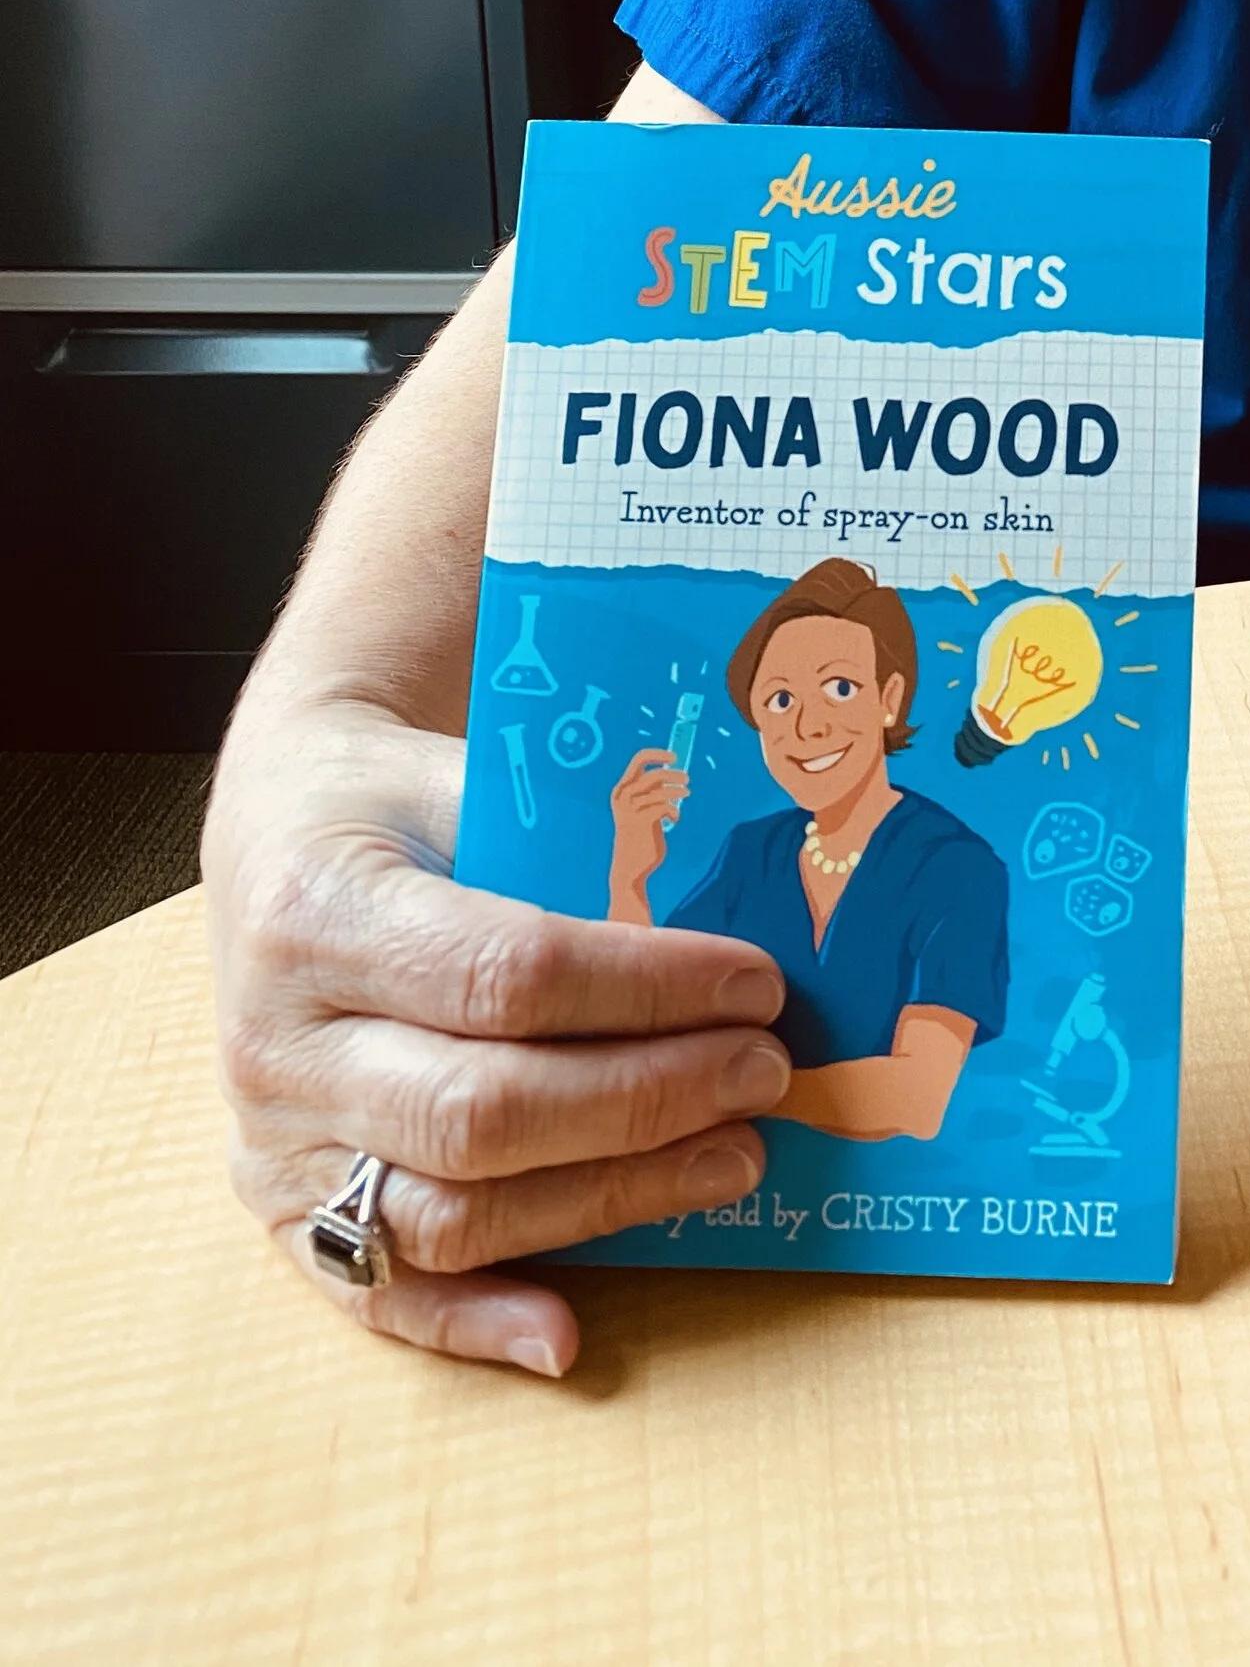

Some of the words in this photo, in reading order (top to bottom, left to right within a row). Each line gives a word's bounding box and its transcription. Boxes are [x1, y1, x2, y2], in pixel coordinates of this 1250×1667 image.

[759, 153, 958, 219] Aussie
[637, 227, 837, 315] STEM
[857, 237, 1069, 311] Stars
[561, 390, 823, 471] FIONA
[853, 396, 1120, 478] WOOD
[619, 491, 764, 526] Inventor
[777, 492, 816, 527] of
[823, 506, 969, 541] spray-on
[983, 496, 1055, 533] skin
[704, 1192, 762, 1227] told
[773, 1192, 810, 1241] by
[822, 1192, 968, 1233] CRISTY
[980, 1196, 1119, 1238] BURNE
